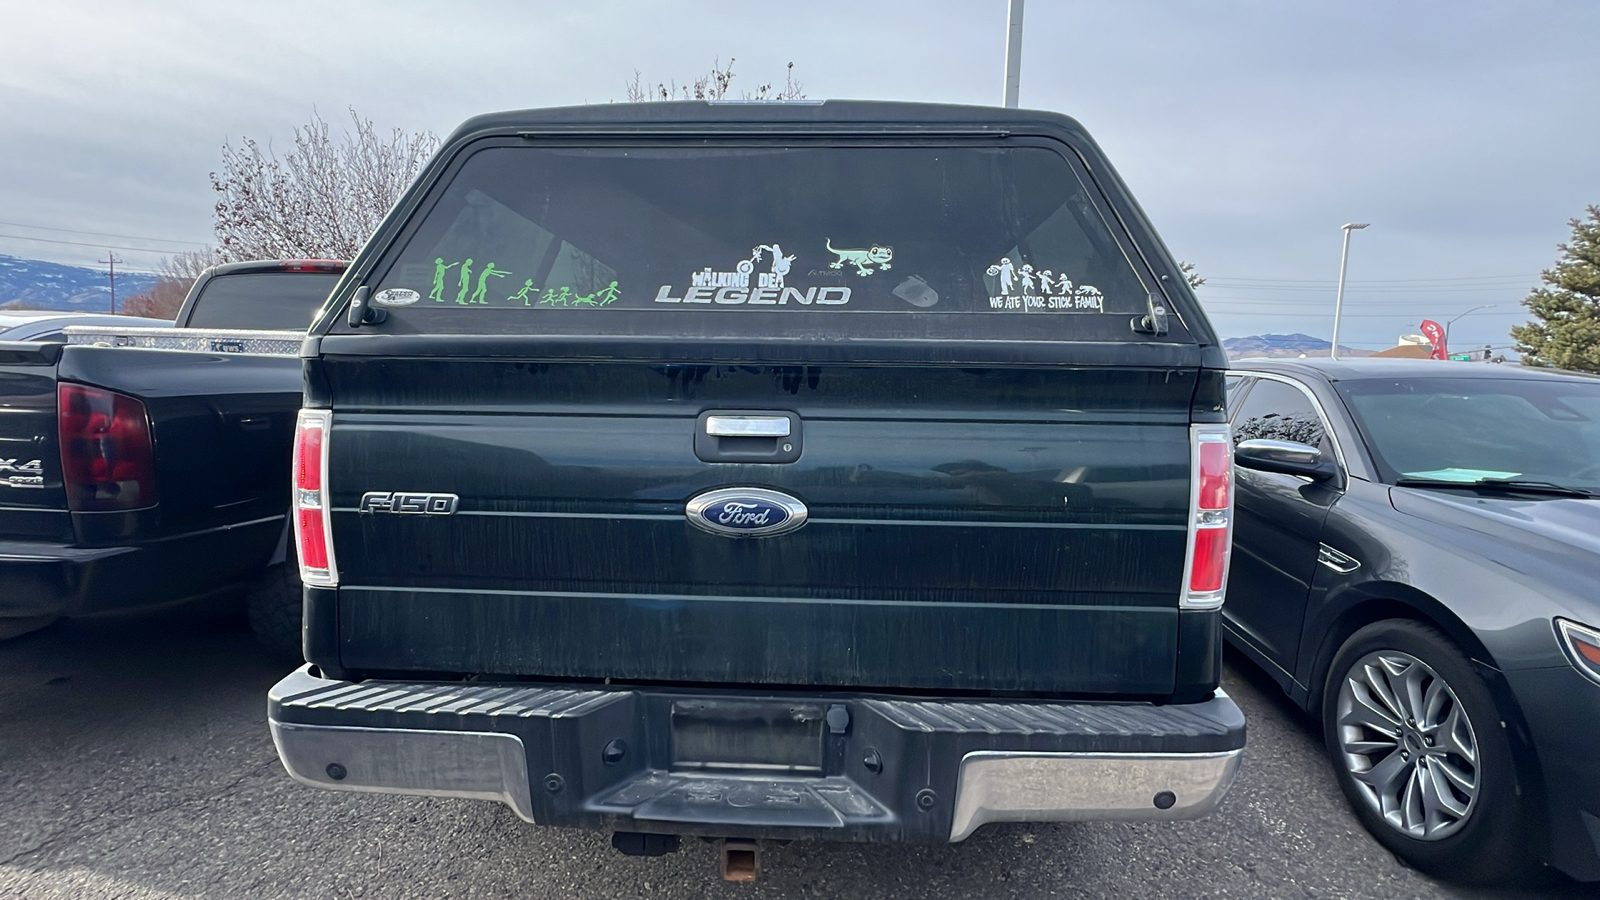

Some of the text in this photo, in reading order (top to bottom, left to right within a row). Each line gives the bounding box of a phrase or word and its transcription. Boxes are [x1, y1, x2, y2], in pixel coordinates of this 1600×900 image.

[655, 285, 851, 305] LEGEND
[989, 294, 1104, 314] WE ATE YOUR STICK FAMILY
[360, 491, 459, 515] F-150
[718, 502, 770, 525] Ford
